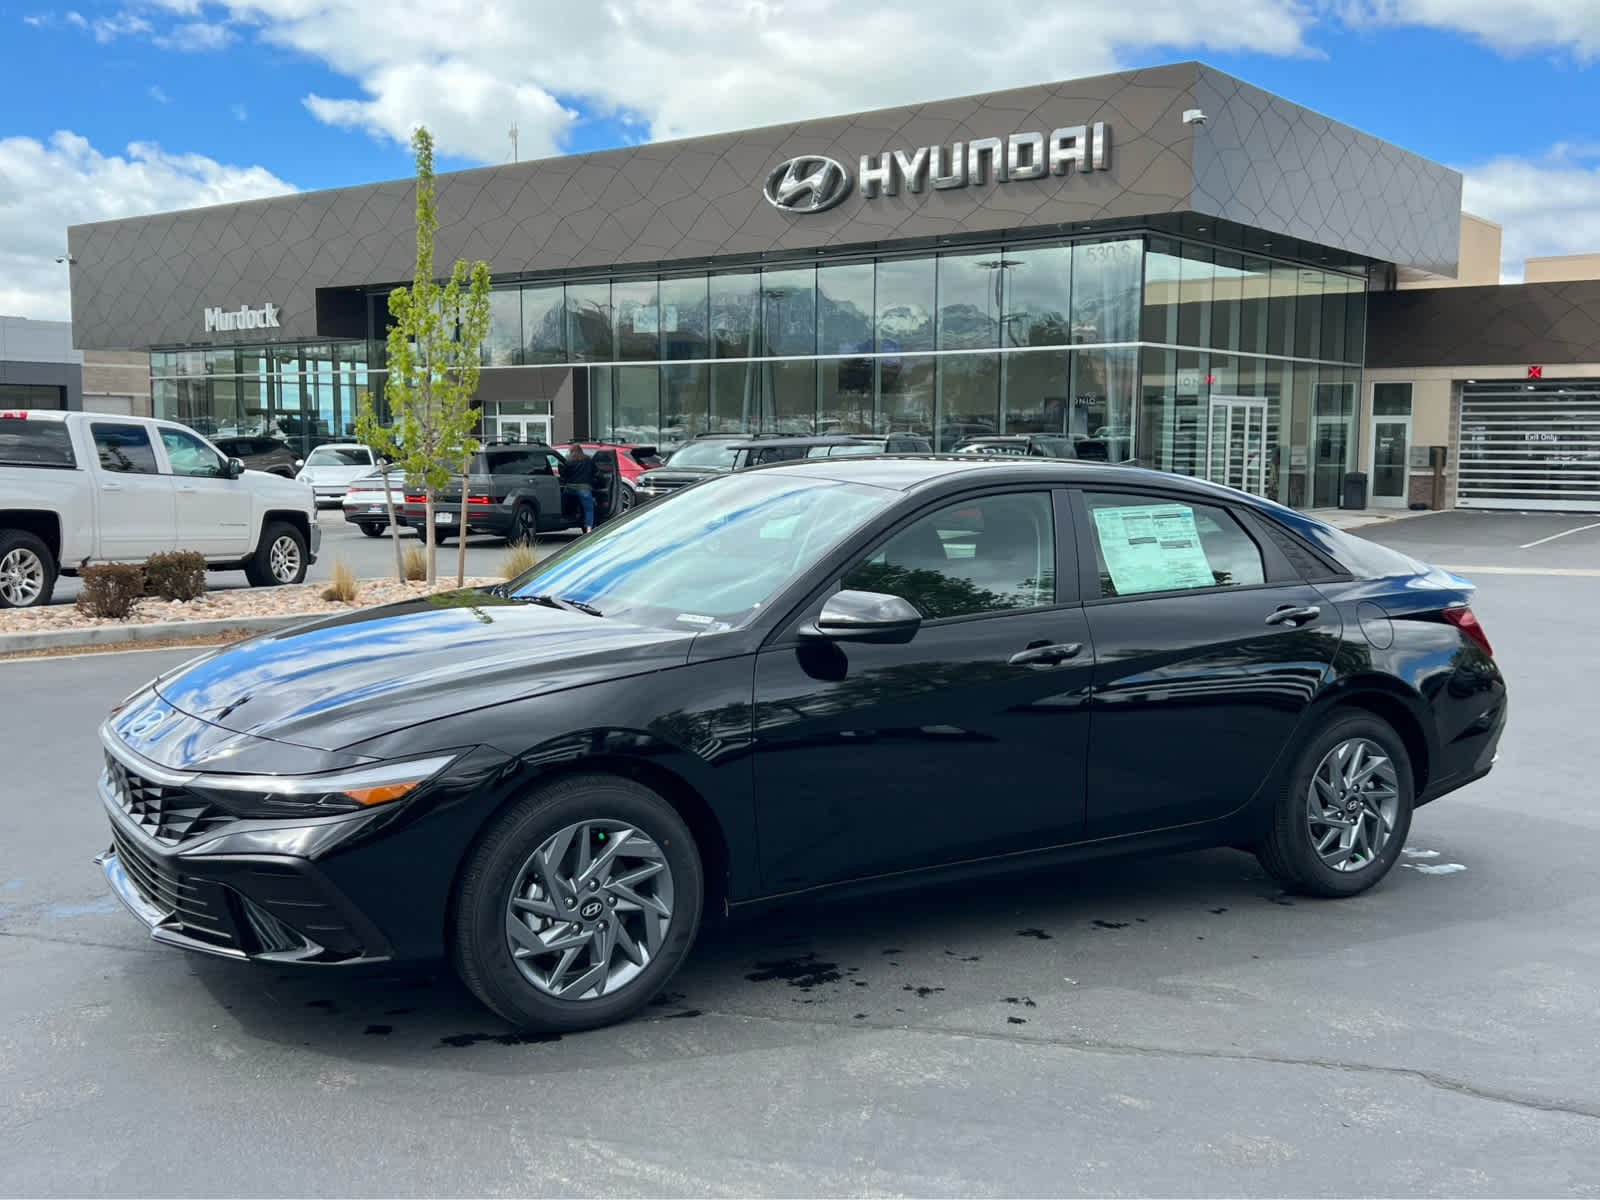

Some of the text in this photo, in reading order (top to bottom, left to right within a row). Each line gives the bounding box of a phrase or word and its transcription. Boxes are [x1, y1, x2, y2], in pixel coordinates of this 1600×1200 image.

[859, 121, 1110, 198] HYUNDAI
[1087, 245, 1118, 264] 530
[204, 302, 280, 332] Murdock
[1540, 431, 1557, 442] Only
